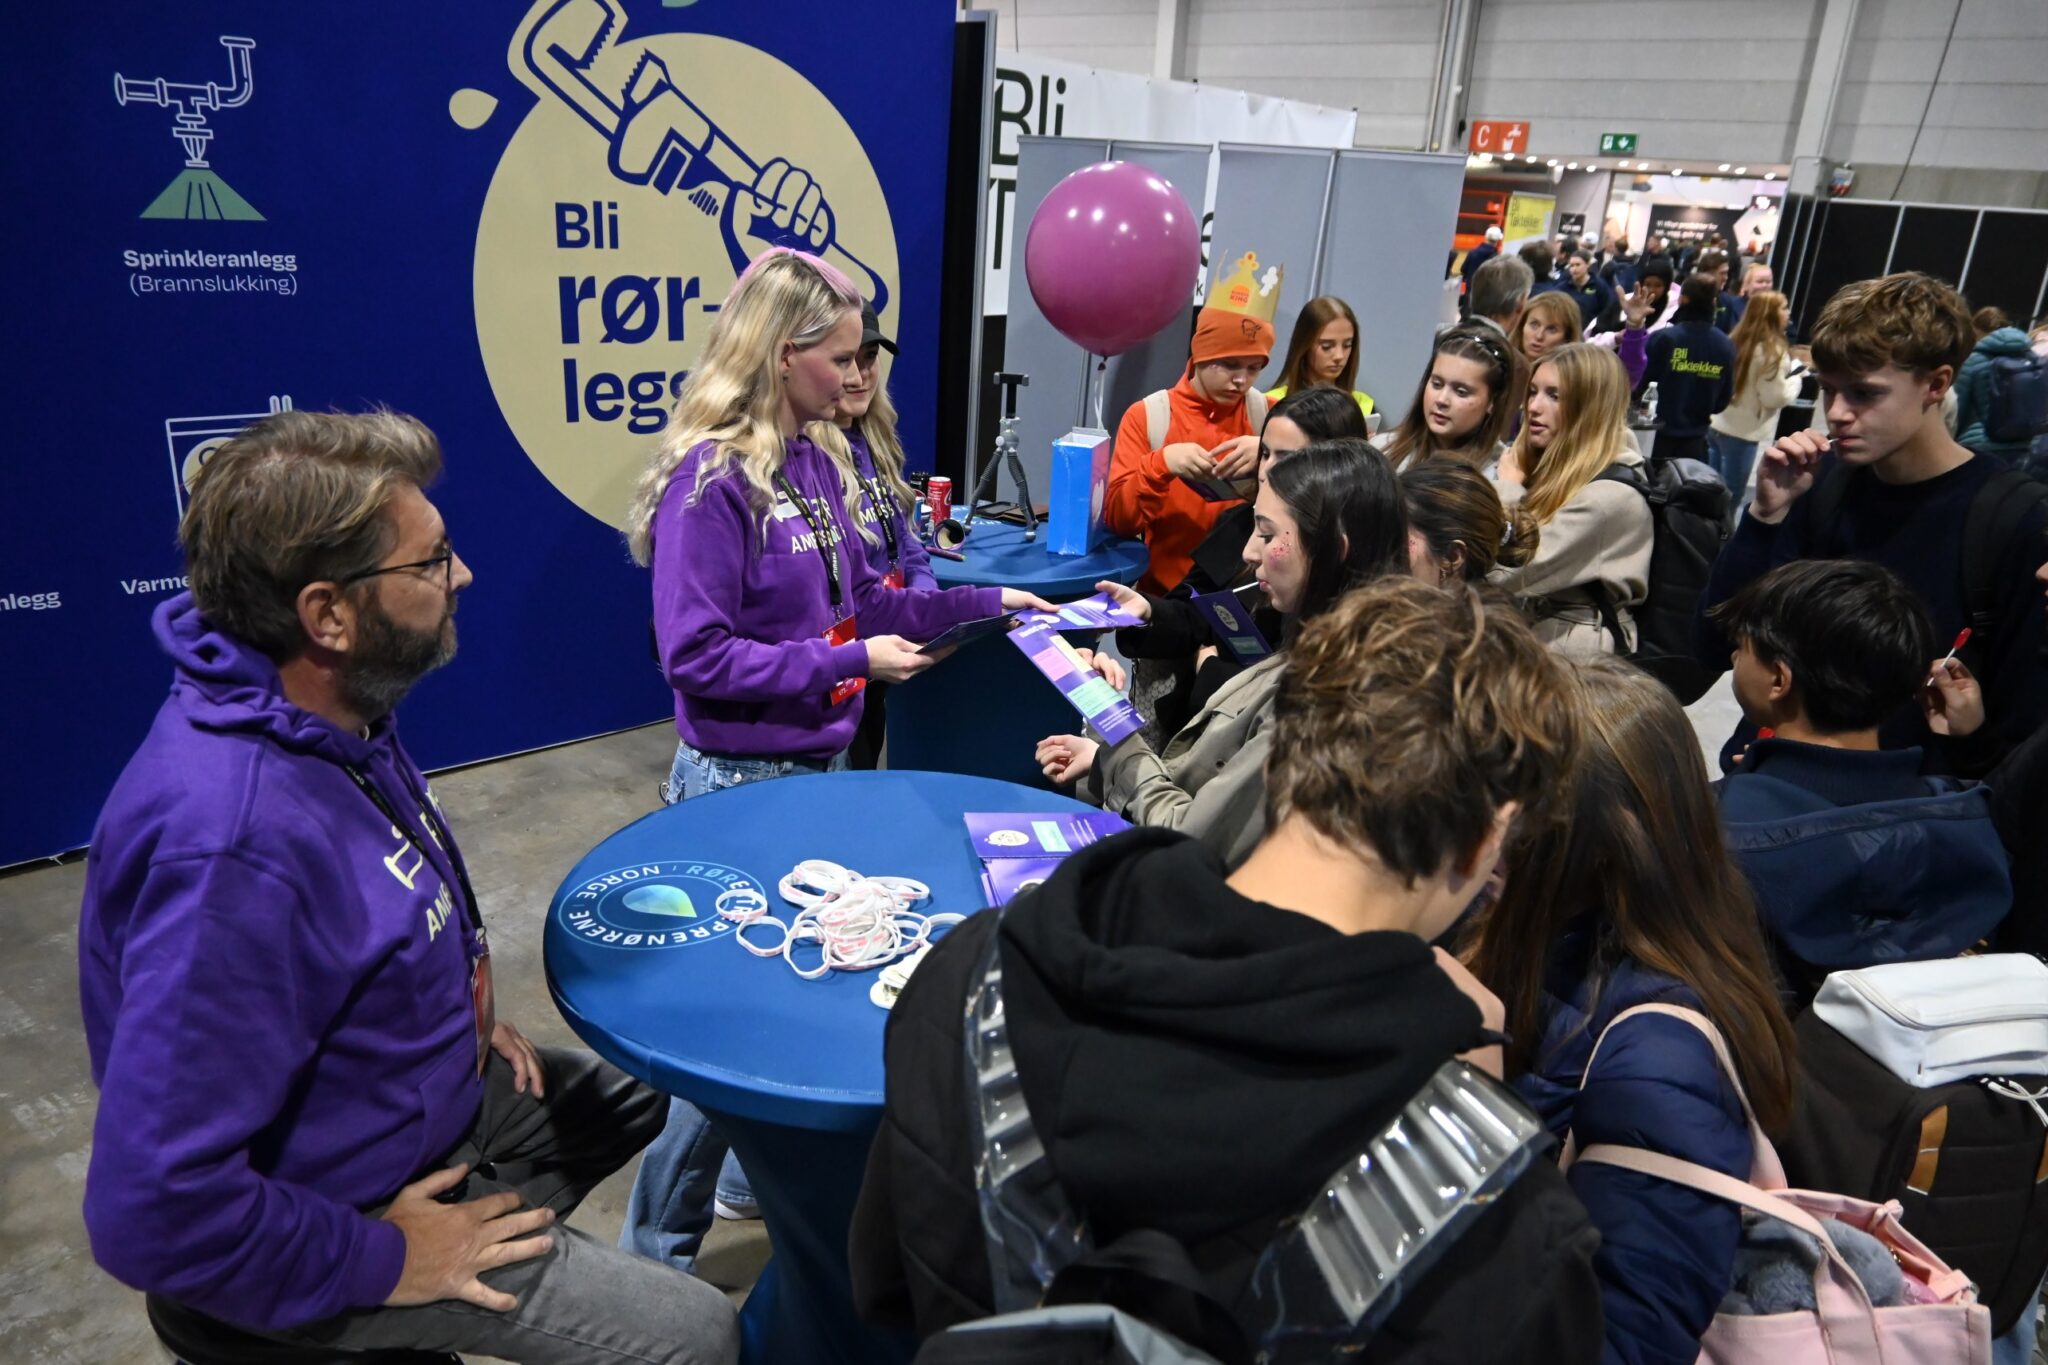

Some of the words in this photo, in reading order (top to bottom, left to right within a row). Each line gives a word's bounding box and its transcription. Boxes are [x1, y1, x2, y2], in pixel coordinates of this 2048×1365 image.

[1477, 124, 1490, 148] C
[555, 200, 619, 249] Bli
[123, 250, 297, 271] Sprinkleranlegg
[130, 273, 297, 297] (Brannslukking)
[558, 274, 722, 345] rør-
[1673, 347, 1688, 359] Bli
[120, 575, 191, 595] Varme
[576, 865, 660, 899] NORGE
